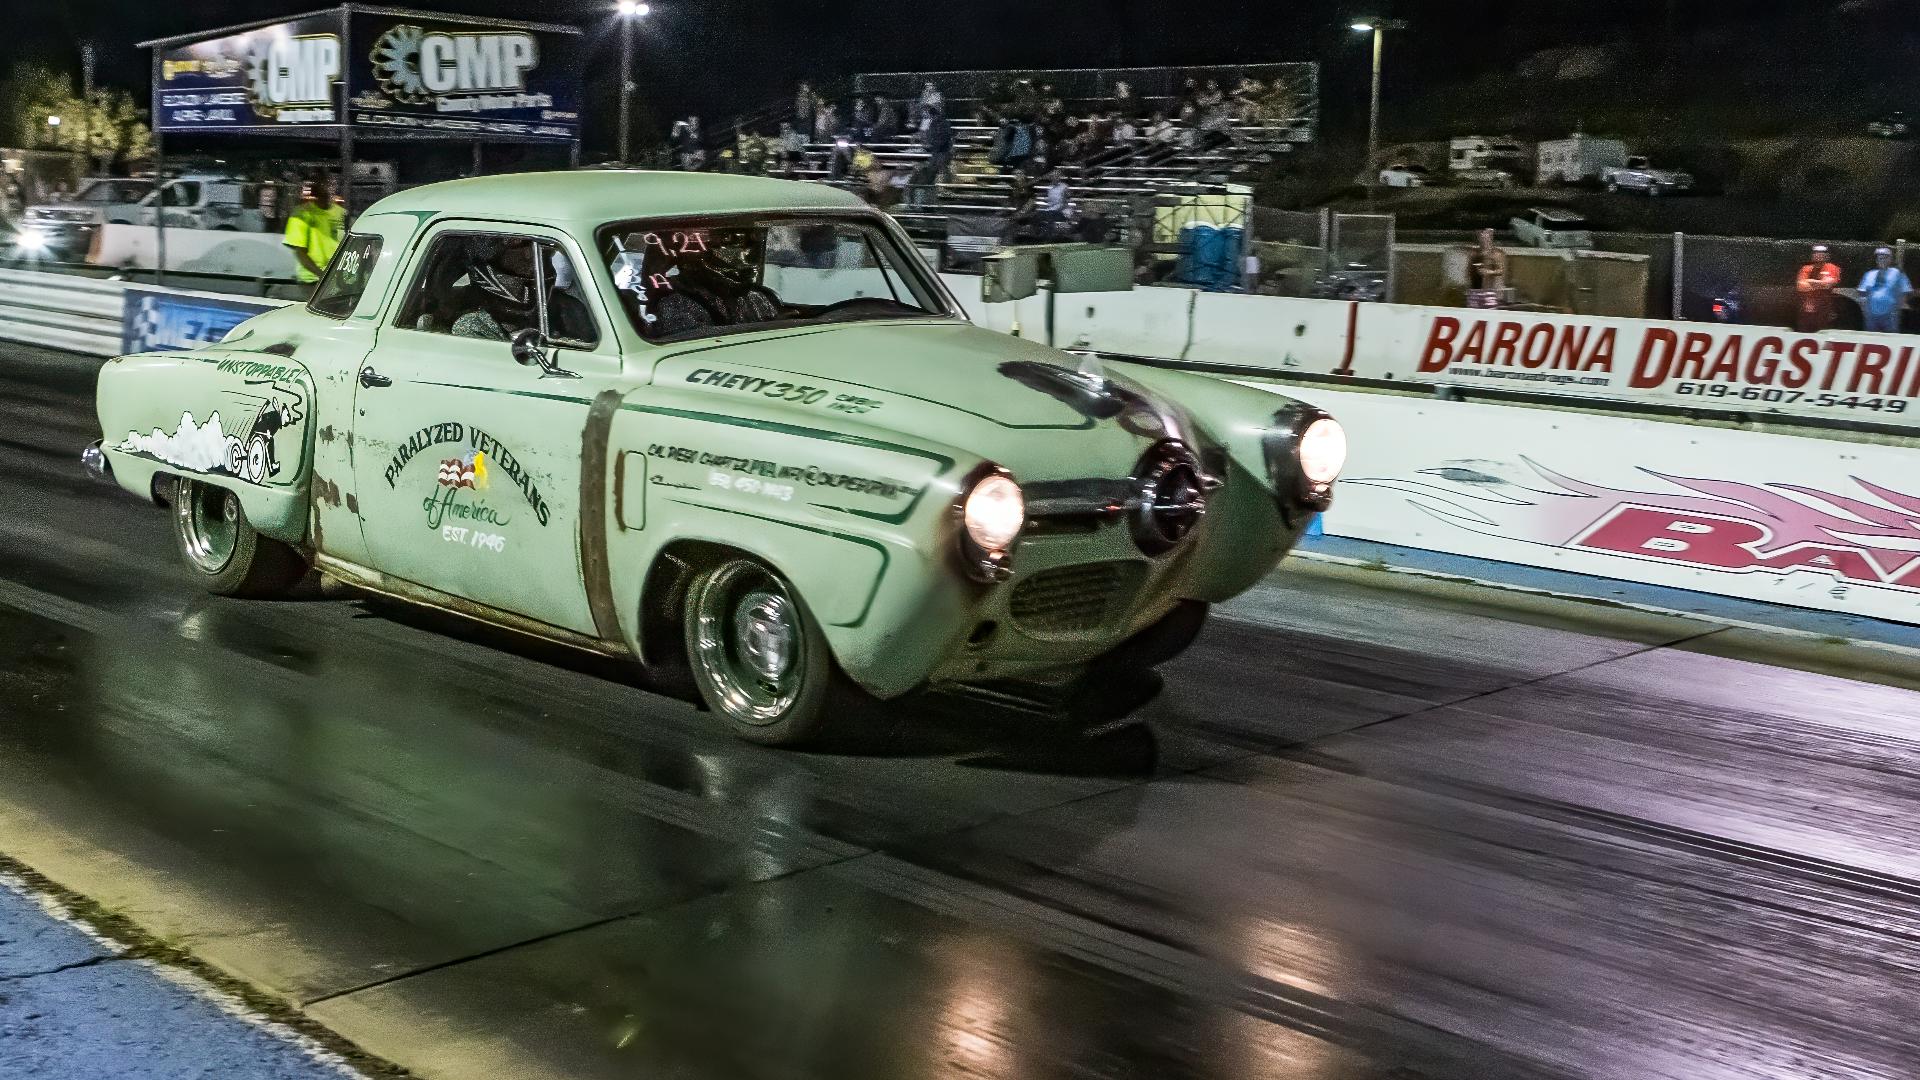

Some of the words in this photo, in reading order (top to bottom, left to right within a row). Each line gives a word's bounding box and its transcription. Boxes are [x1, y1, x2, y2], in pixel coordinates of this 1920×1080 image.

[268, 36, 340, 102] CMP
[420, 34, 537, 92] CMP
[1416, 316, 1618, 373] BARONA
[1628, 327, 1920, 398] DRAGSTRI
[1676, 382, 1907, 414] 619-607-5449
[385, 422, 464, 491] PARALYZED
[469, 425, 551, 527] VETERANS
[436, 487, 512, 528] America
